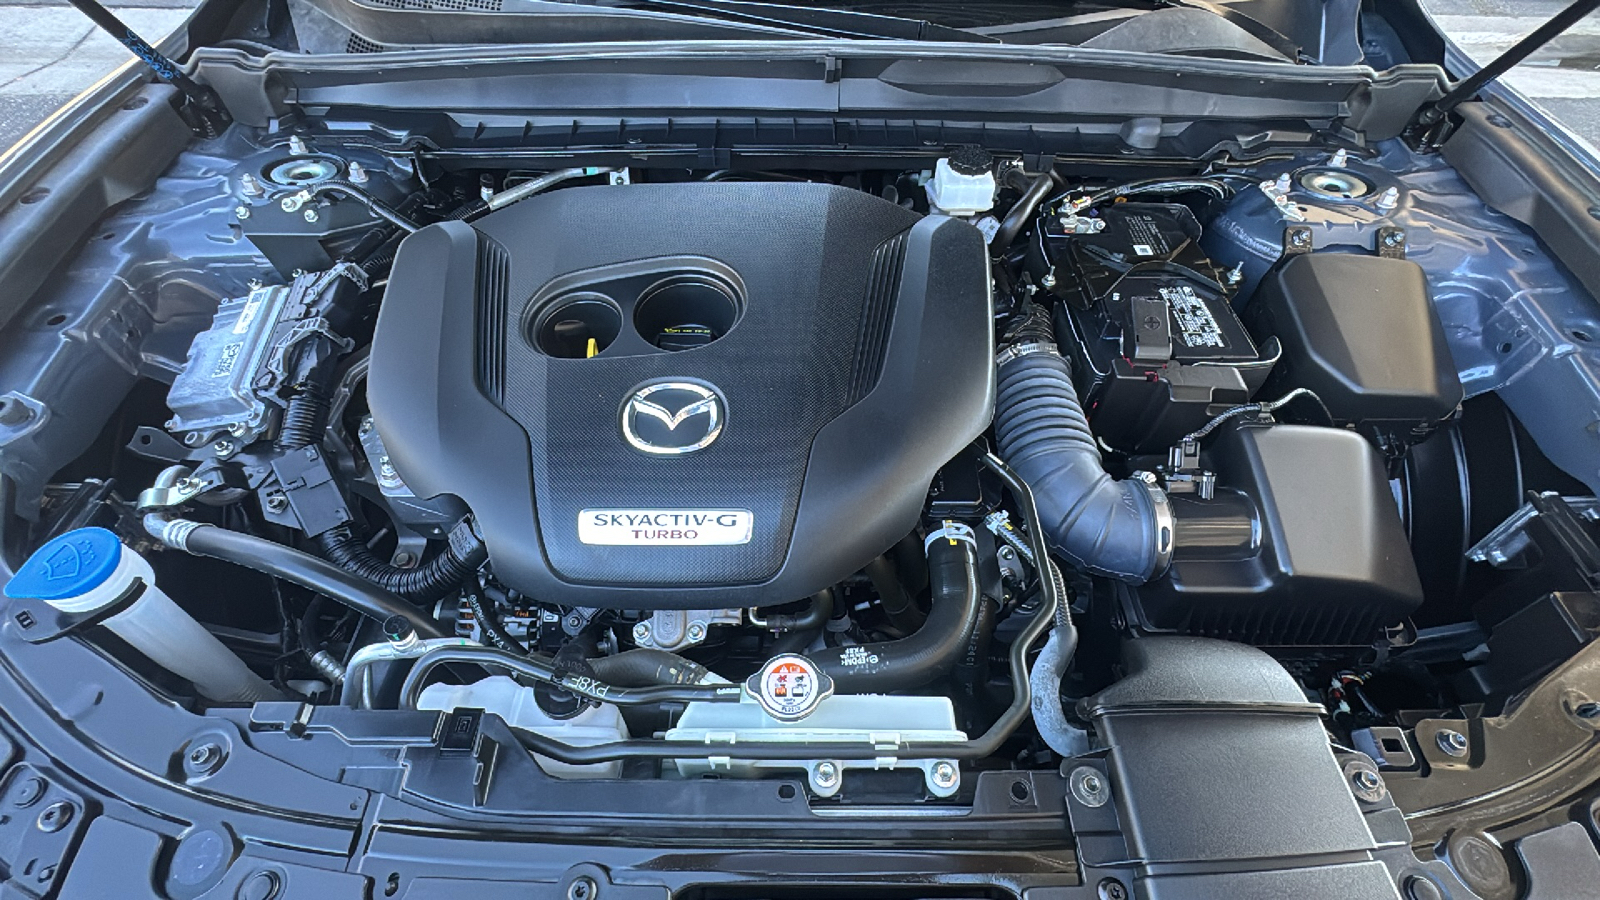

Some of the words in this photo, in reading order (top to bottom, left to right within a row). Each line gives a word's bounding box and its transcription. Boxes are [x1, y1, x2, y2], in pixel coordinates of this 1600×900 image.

[593, 513, 738, 527] SKYACTIV-G
[631, 529, 699, 539] TURBO
[567, 676, 611, 698] PX8F
